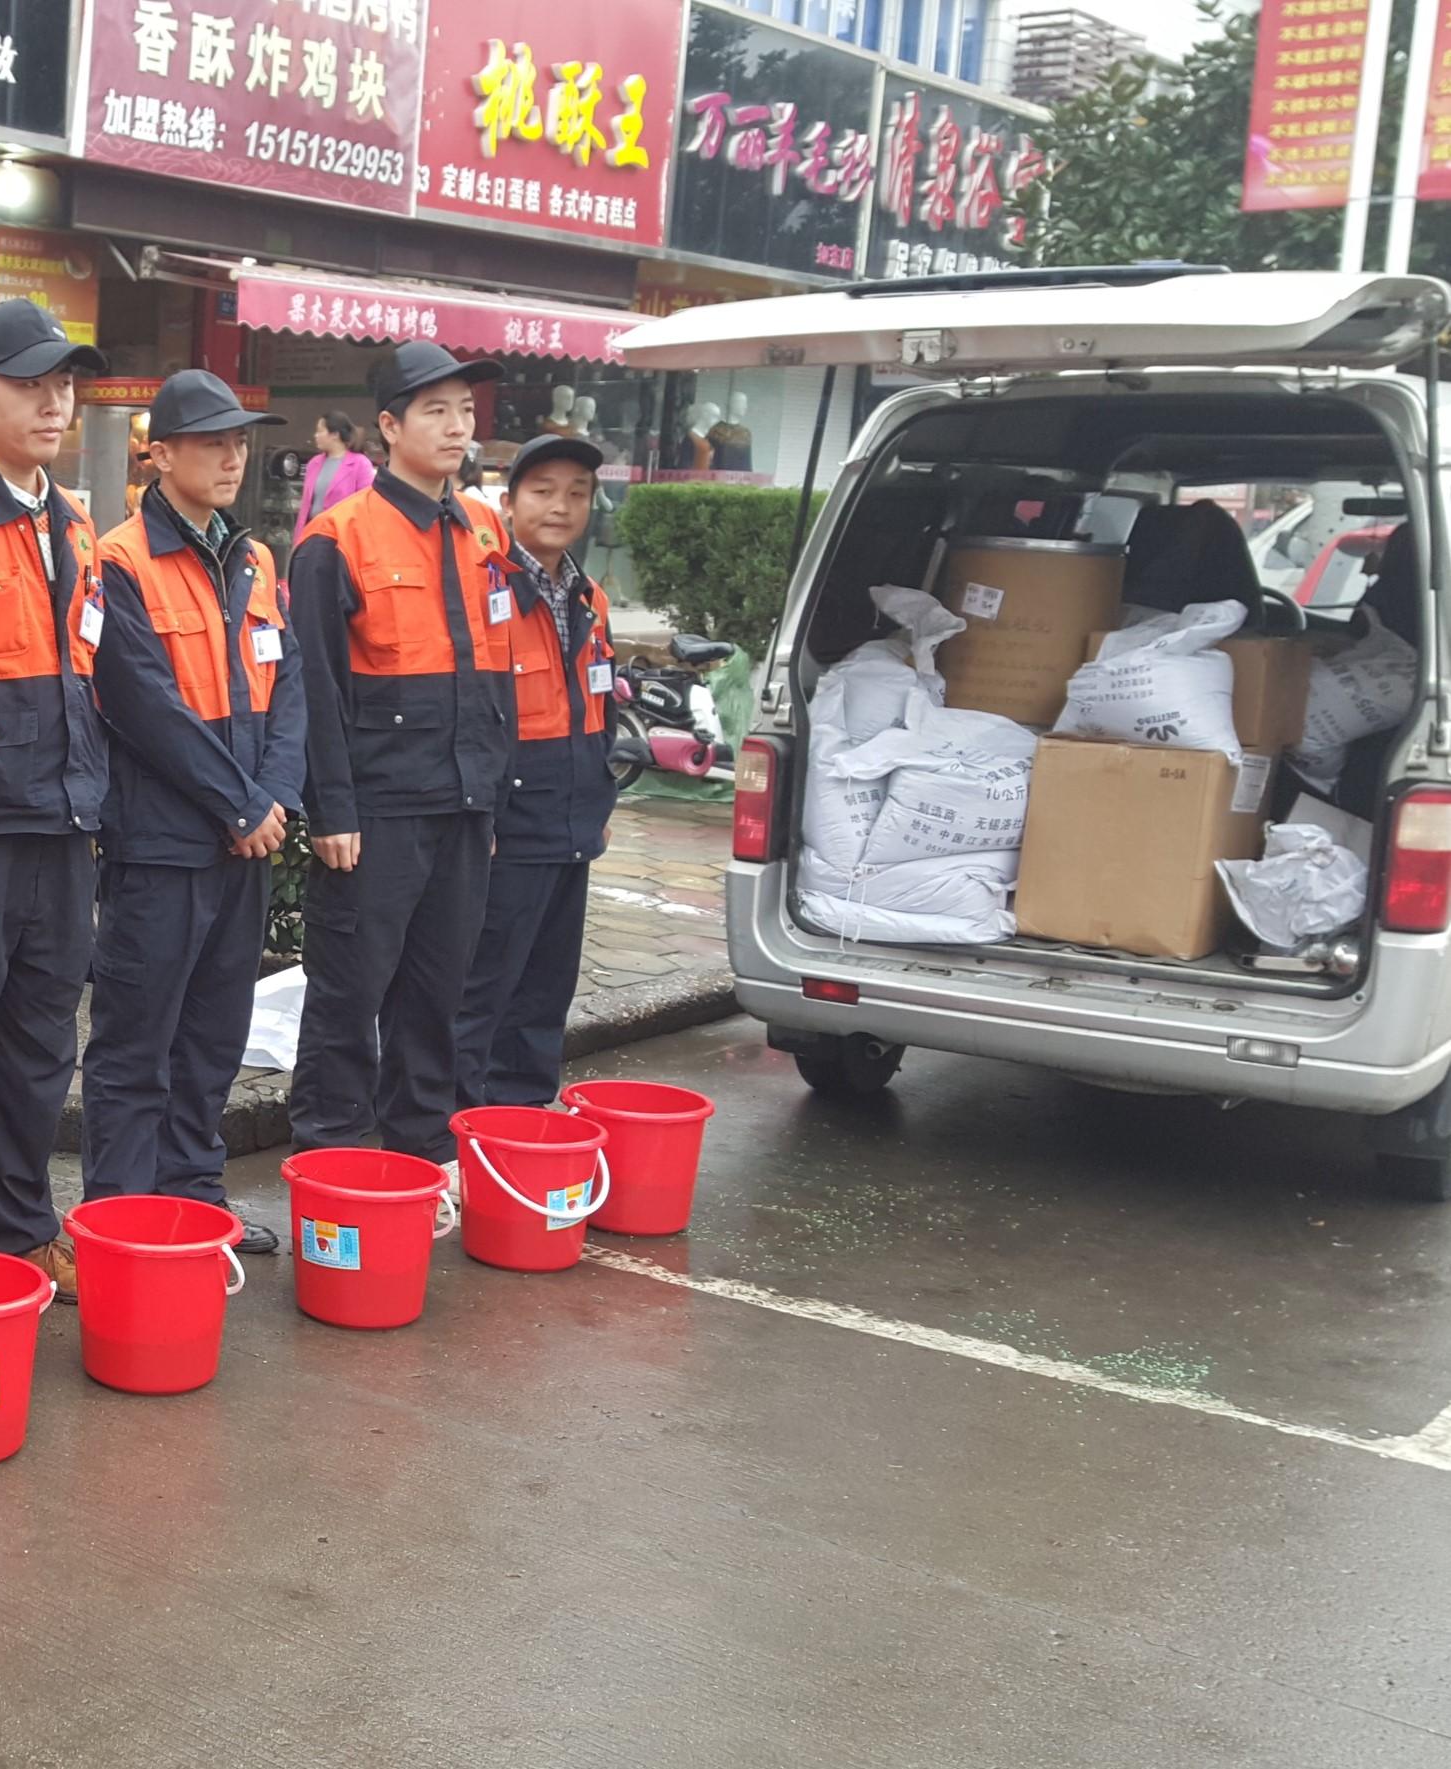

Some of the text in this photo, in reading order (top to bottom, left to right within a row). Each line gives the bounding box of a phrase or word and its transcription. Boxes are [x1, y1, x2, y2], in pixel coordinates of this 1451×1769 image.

[133, 0, 387, 119] 香酥炸鸡块
[471, 38, 649, 169] 桃酥王
[245, 121, 404, 186] 15151329953
[440, 163, 541, 213] 定制生日蛋糕
[549, 183, 637, 229] 各式中西糕点
[505, 317, 564, 350] 桃酥王
[939, 829, 1022, 846] 中国江苏无锡
